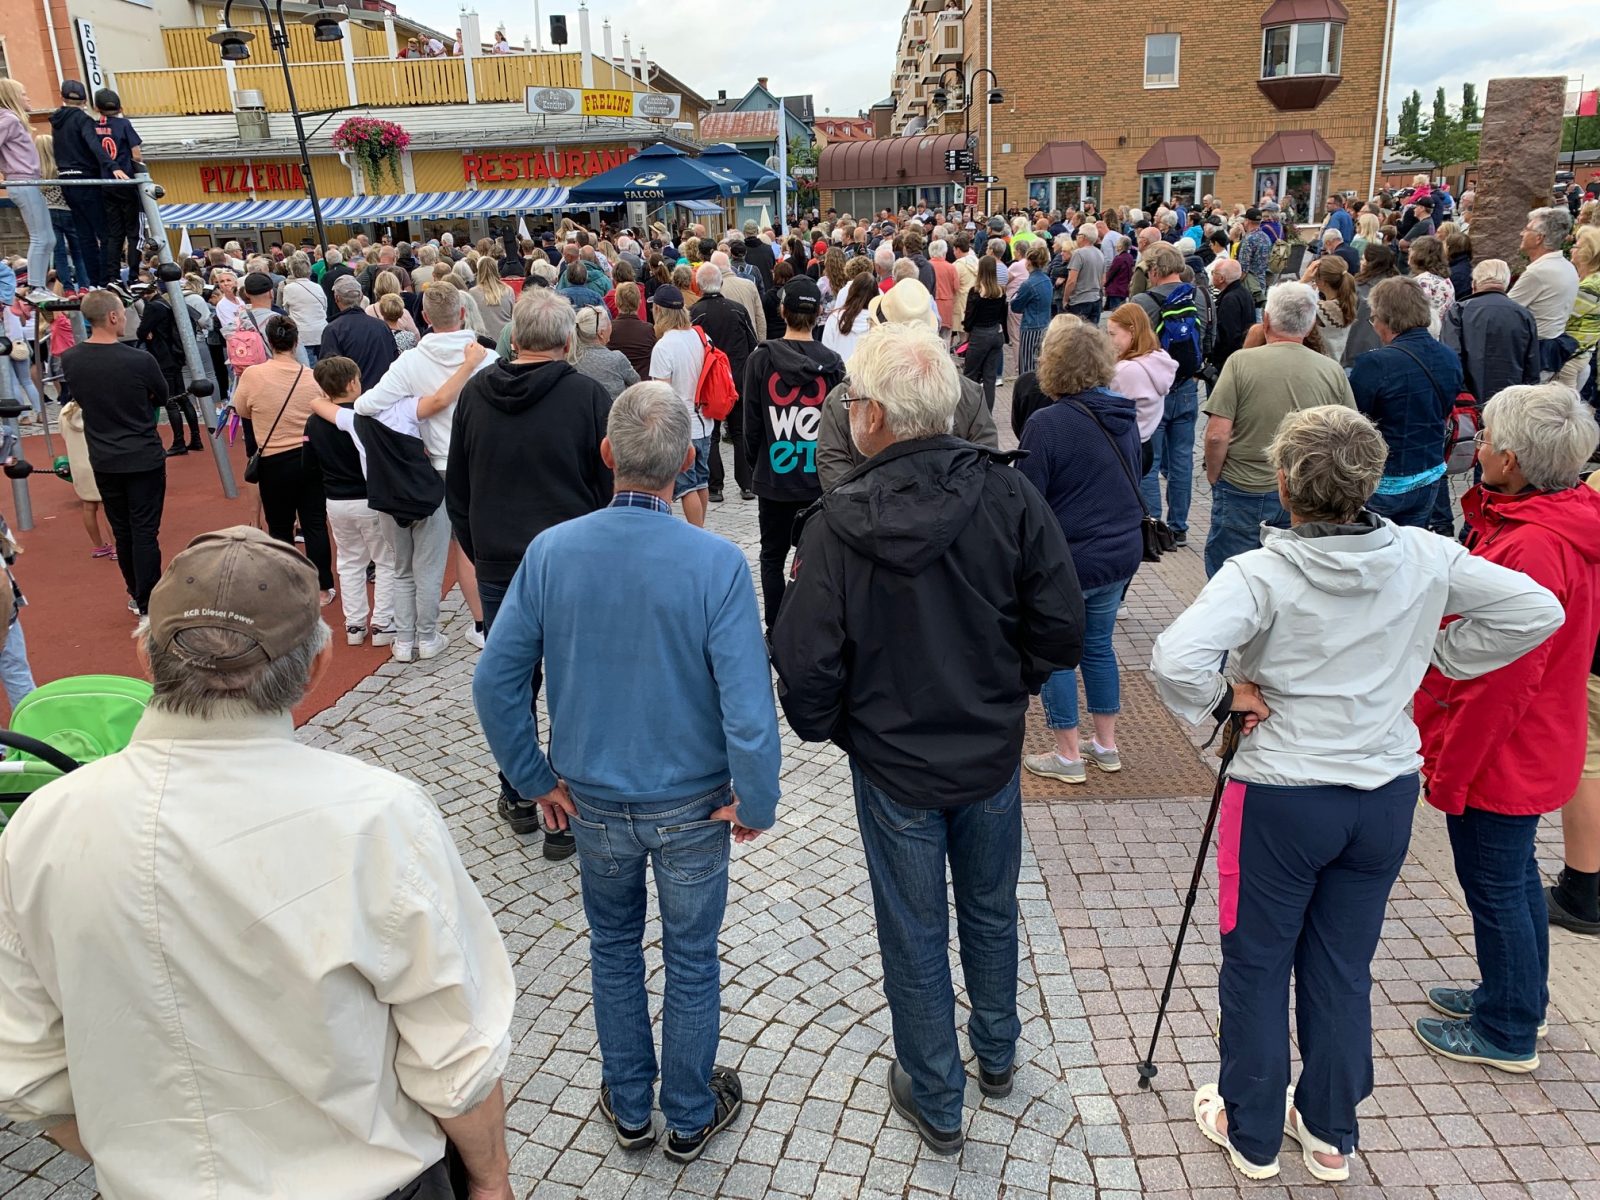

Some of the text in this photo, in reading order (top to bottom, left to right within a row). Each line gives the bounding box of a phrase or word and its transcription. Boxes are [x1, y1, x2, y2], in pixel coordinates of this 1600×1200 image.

[83, 24, 102, 86] FOTO
[584, 92, 631, 114] FRELINS
[199, 163, 306, 193] PIZZERIA
[624, 190, 664, 199] FALCON
[183, 608, 255, 625] KCR Diesel Power
